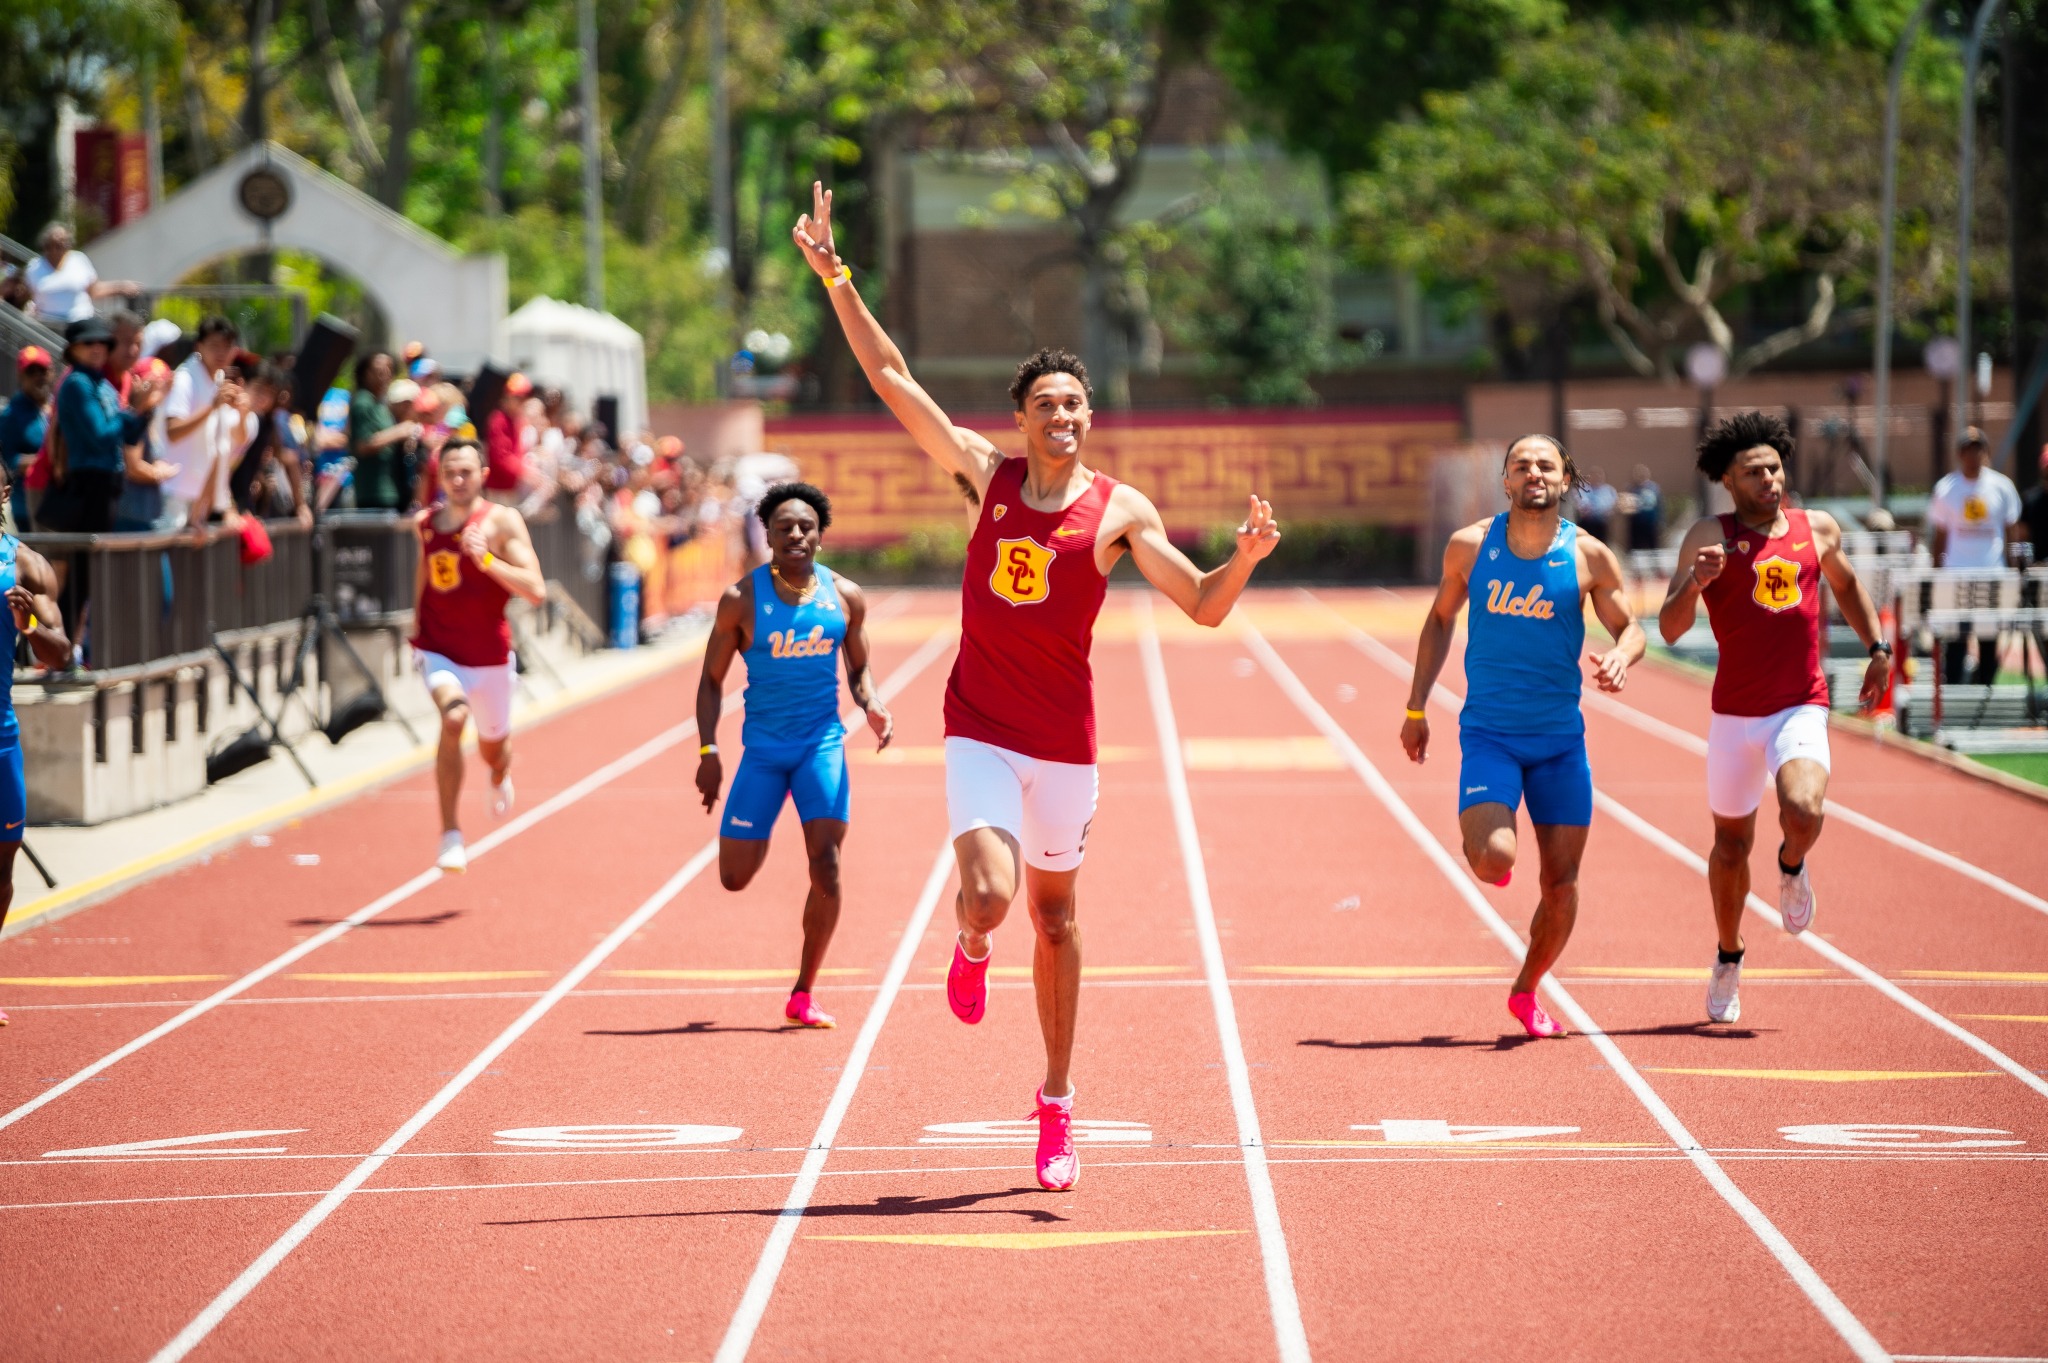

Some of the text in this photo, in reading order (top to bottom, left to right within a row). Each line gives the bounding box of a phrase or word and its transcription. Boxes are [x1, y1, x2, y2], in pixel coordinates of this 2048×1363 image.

[1007, 546, 1036, 596] SC
[1765, 566, 1789, 602] SC
[1487, 578, 1555, 620] Ucla
[768, 624, 835, 659] Ucla
